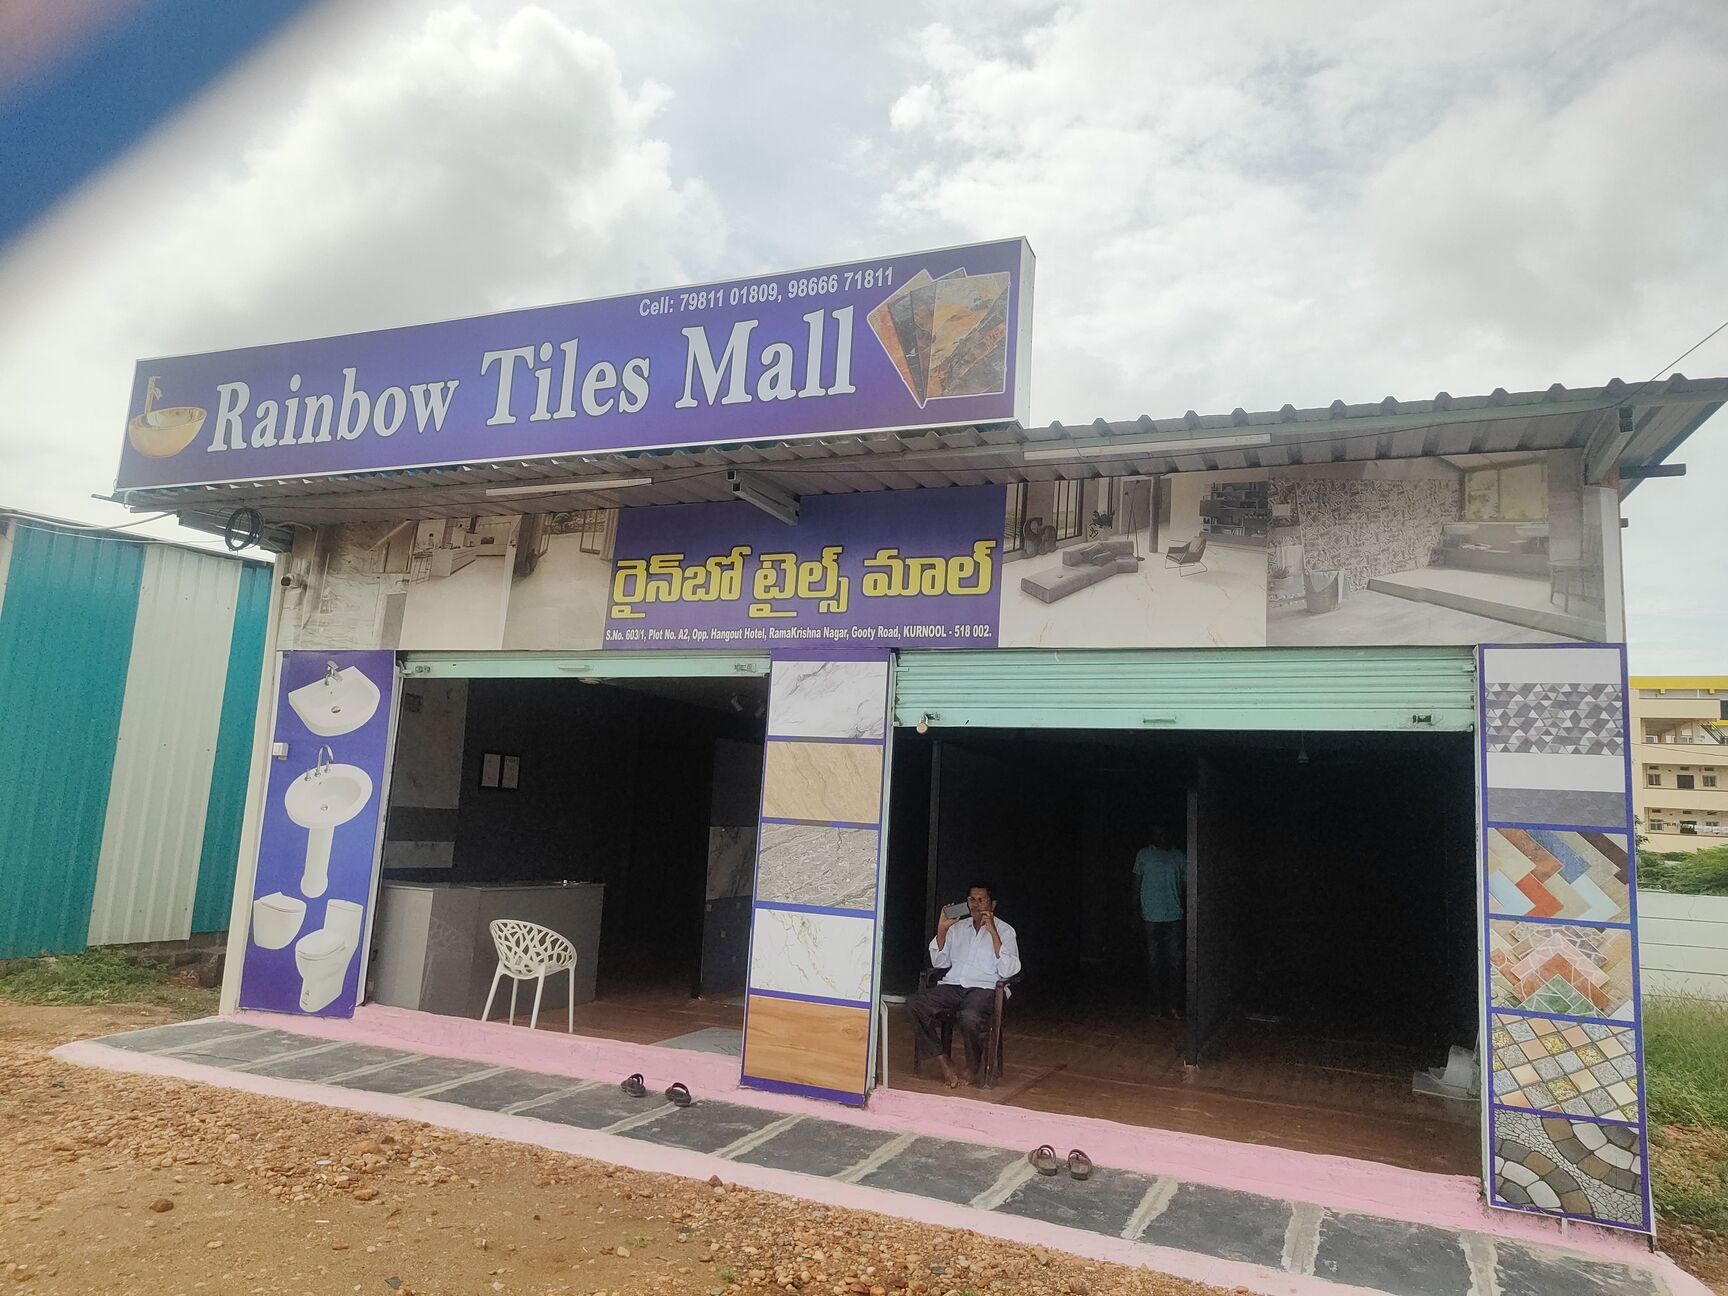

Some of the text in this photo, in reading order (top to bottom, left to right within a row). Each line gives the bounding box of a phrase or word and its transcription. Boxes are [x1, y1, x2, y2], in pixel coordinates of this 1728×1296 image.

[639, 266, 893, 317] Cell: 79811 01809, 98666 71811
[207, 305, 856, 452] Rainbow Tiles Mall
[606, 629, 624, 640] S.No.
[626, 629, 647, 641] 603/1,
[649, 629, 663, 640] Plot
[664, 629, 677, 640] No.
[678, 629, 691, 641] A2,
[692, 628, 709, 642] Opp.
[711, 628, 743, 642] Hangout
[744, 627, 767, 640] Hotel,
[769, 626, 821, 639] RamaKrishna
[823, 626, 849, 640] Nagar,
[851, 626, 875, 640] Gooty
[877, 625, 900, 640] Road,
[903, 625, 947, 638] KURNOOL
[954, 625, 971, 637] 518
[973, 625, 992, 637] 002.
